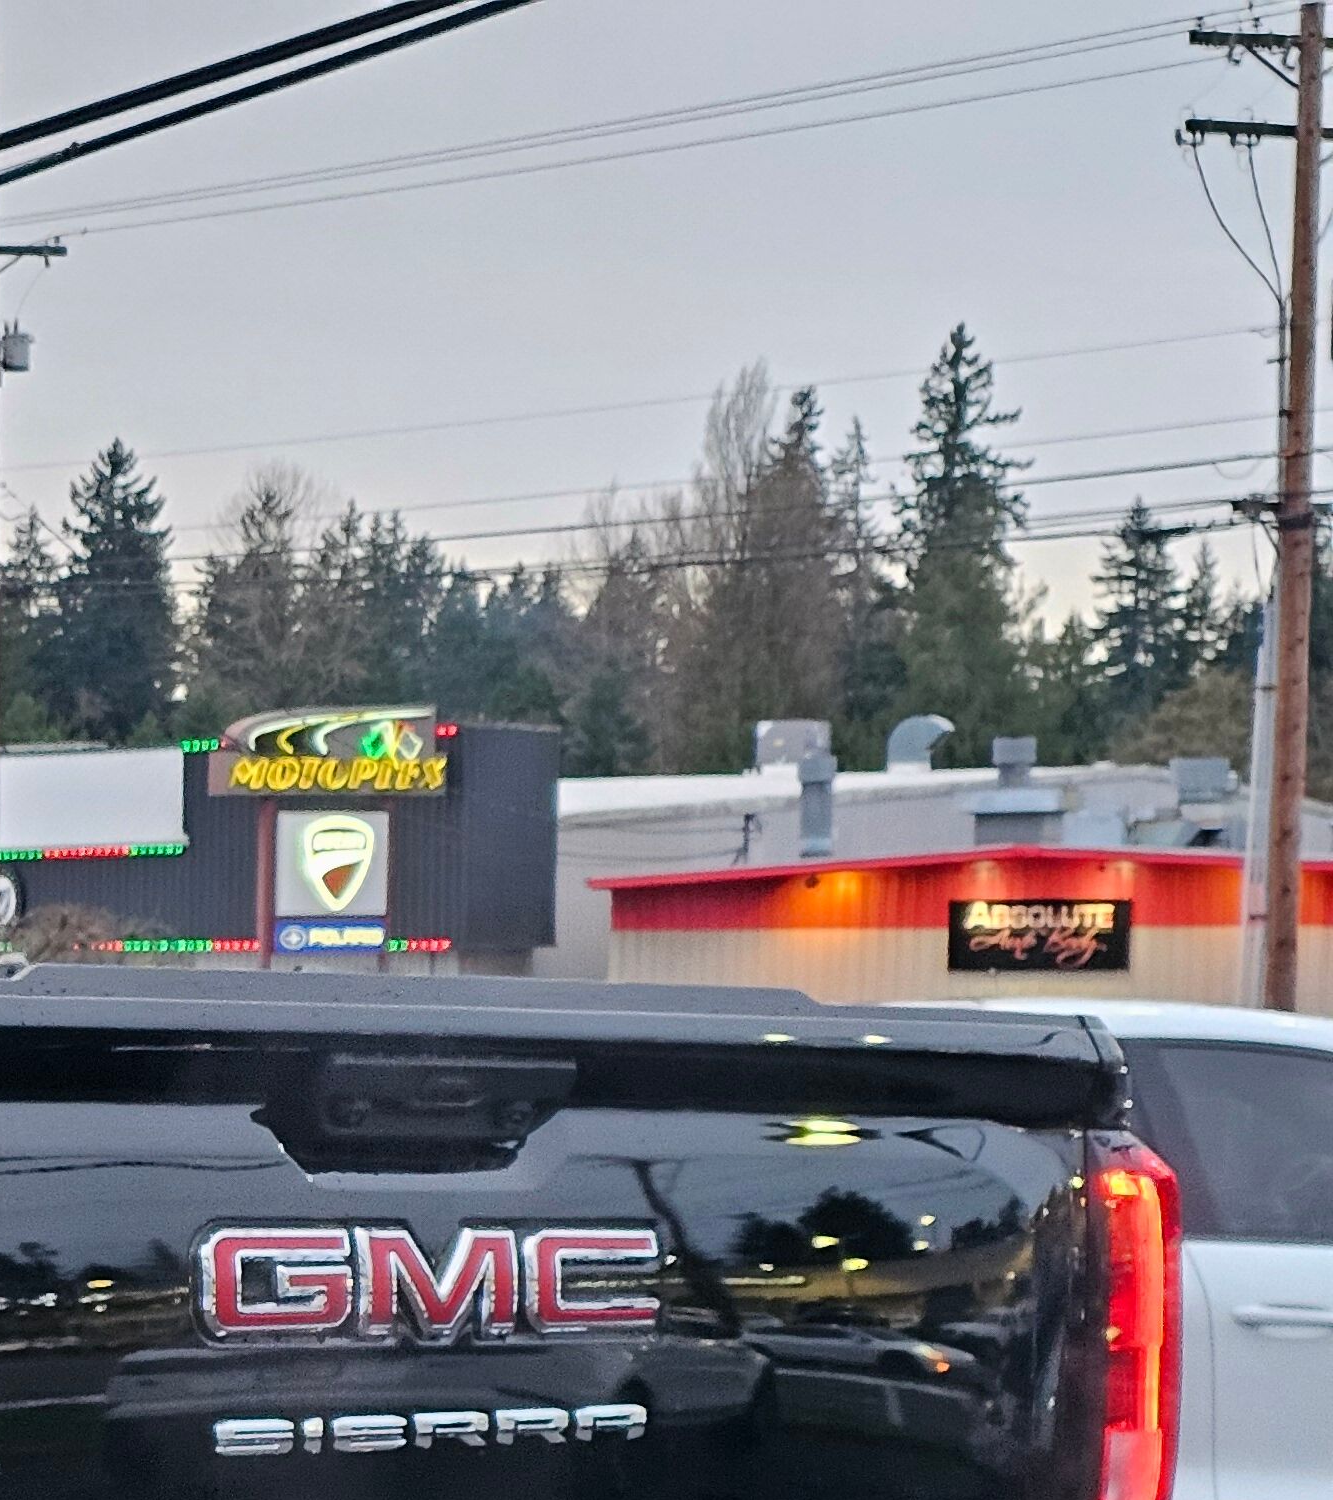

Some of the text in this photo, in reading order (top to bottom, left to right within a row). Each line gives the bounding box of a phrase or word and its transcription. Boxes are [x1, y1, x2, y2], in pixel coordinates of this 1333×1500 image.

[963, 901, 1116, 929] ABSOLUTE
[200, 1226, 661, 1338] GMC
[213, 1403, 649, 1456] SIERRA
